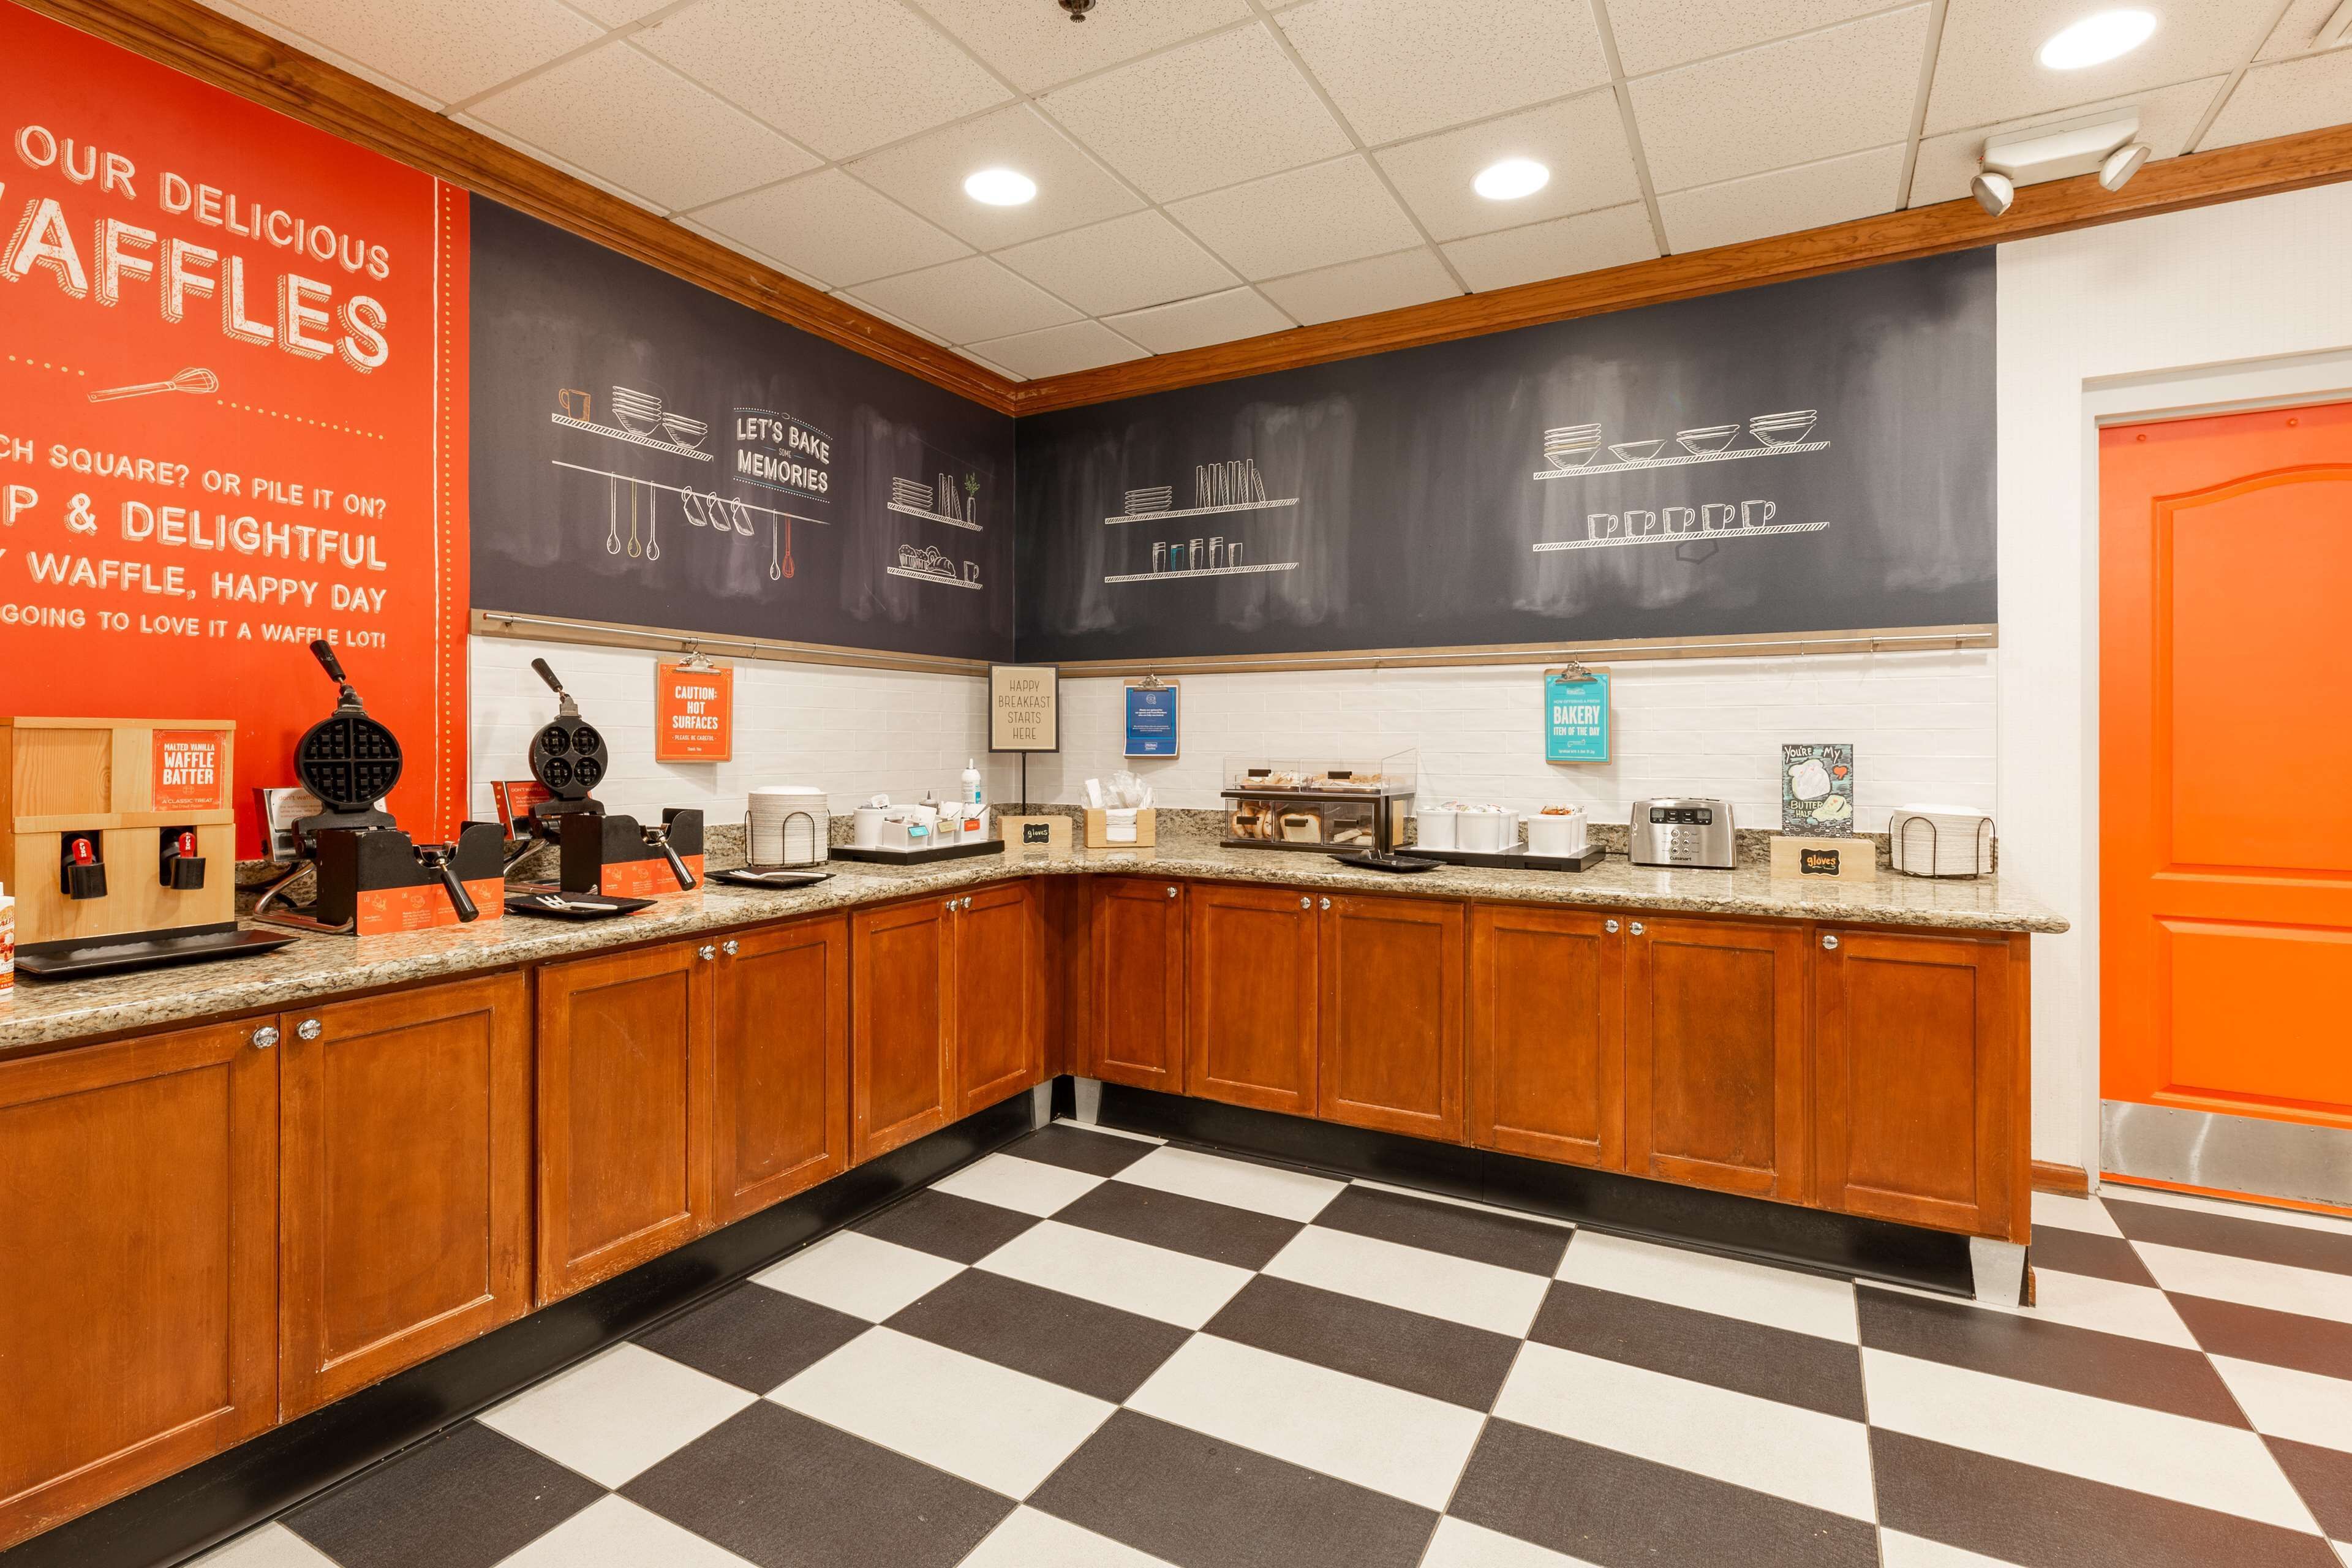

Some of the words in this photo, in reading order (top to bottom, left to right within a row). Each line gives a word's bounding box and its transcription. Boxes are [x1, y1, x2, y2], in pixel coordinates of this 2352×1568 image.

[15, 125, 136, 200] OUR
[160, 172, 390, 281] DELICIOUS
[0, 182, 389, 374] AFFLES
[737, 418, 783, 443] LET'S
[789, 426, 829, 464] BAKE
[778, 448, 792, 459] SOME
[738, 449, 828, 493] MEMORIES
[49, 444, 189, 488] SQUARE?
[202, 470, 241, 497] OR
[252, 478, 304, 506] PILE
[314, 489, 334, 510] IT
[344, 494, 386, 519] ON?
[3, 484, 39, 527] P
[64, 493, 98, 537] &
[122, 501, 386, 571] DELIGHTFUL
[26, 551, 196, 601] WAFFLE,
[212, 571, 318, 608] HAPPY
[331, 584, 386, 614] DAY
[0, 603, 86, 629] GOING
[97, 611, 130, 631] TO
[140, 614, 200, 637] LOVE
[209, 620, 228, 639] IT
[237, 622, 252, 640] A
[346, 630, 386, 649] LOT!
[675, 686, 717, 700] CAUTION:
[1010, 680, 1039, 692] HAPPY
[687, 701, 705, 714] HOT
[999, 695, 1050, 708] BREAKFAST
[673, 715, 718, 729] SURFACES
[1008, 712, 1041, 723] STARTS
[1553, 706, 1600, 725] BAKERY
[1013, 727, 1036, 739] HERE
[1553, 726, 1567, 736] ITEM
[1568, 727, 1575, 736] OF
[1577, 727, 1588, 736] THE
[1589, 727, 1600, 736] DAY
[164, 752, 215, 767] WAFFLE
[163, 768, 214, 785] BATTER
[1790, 800, 1823, 810] BUTTER
[1028, 828, 1048, 839] gloves
[1807, 854, 1836, 867] gloves
